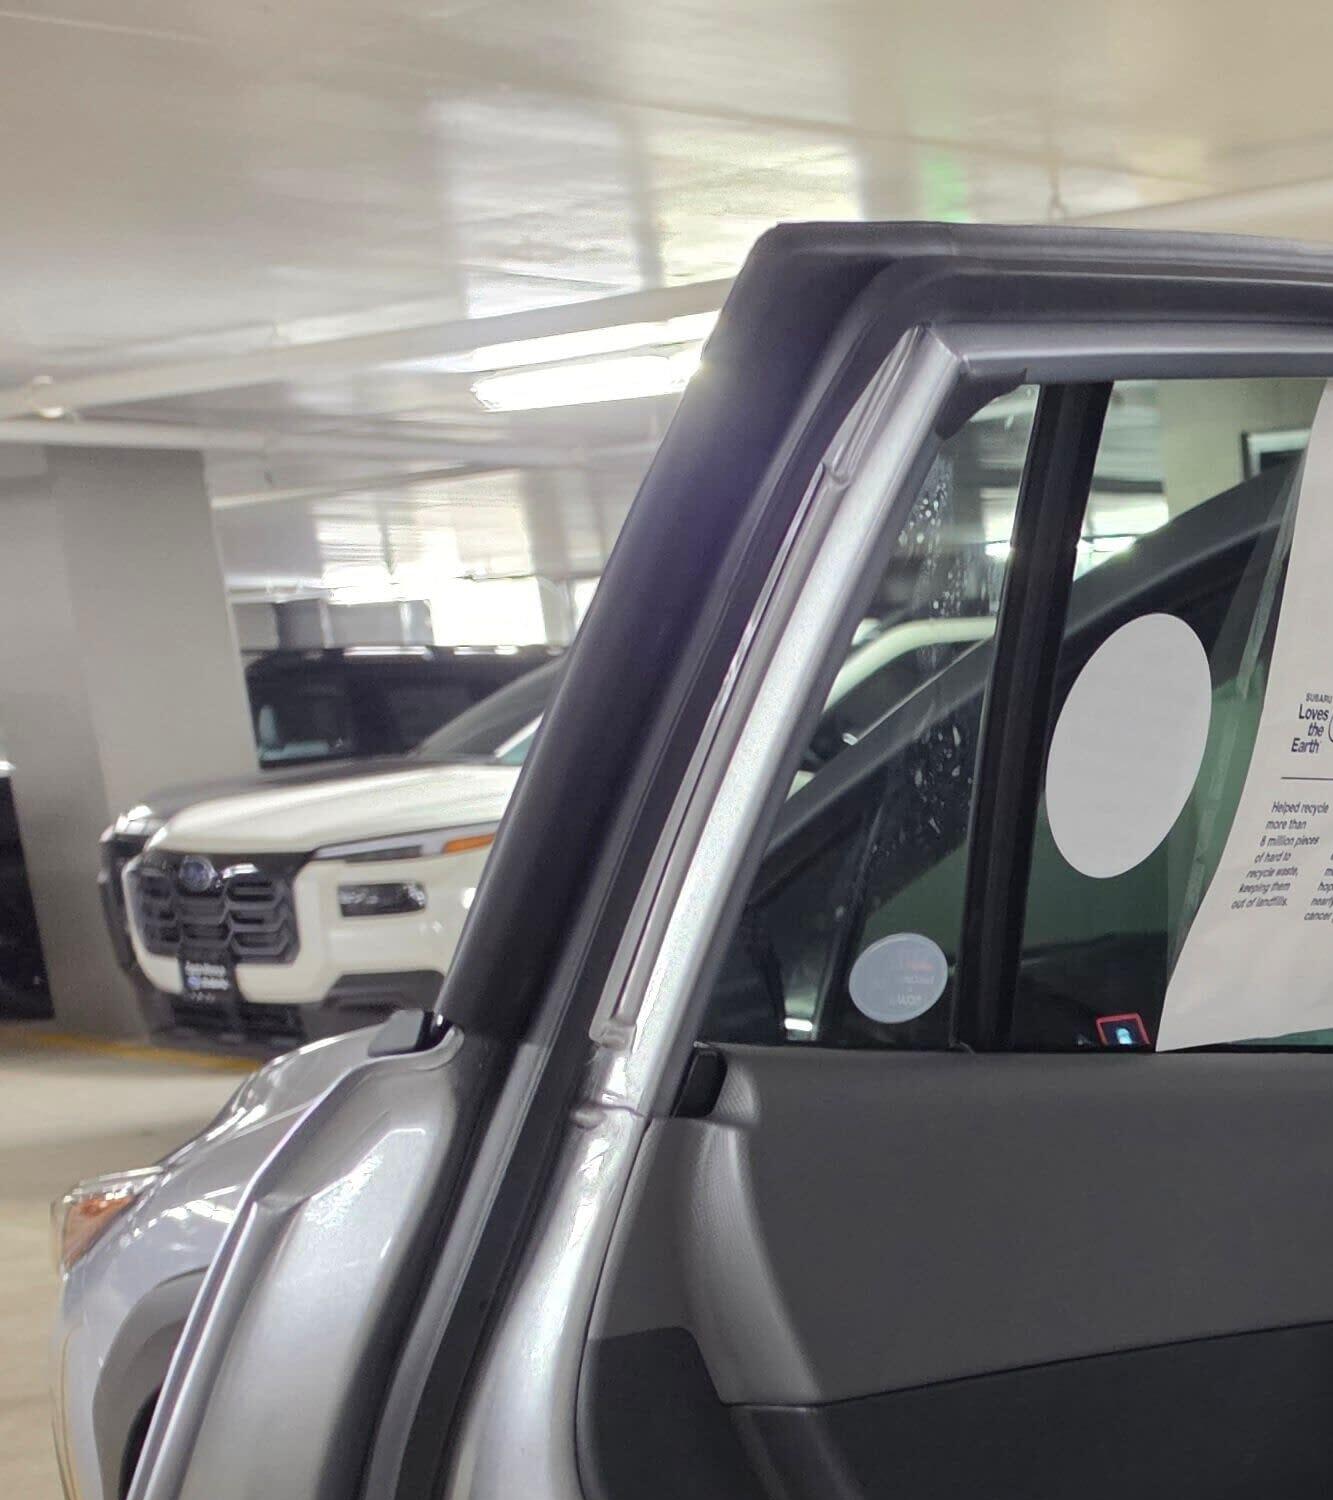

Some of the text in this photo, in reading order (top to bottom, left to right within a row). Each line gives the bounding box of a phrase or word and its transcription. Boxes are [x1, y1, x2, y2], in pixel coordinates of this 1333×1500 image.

[1306, 693, 1333, 704] SUBARU
[1299, 704, 1329, 721] Loves
[1308, 722, 1325, 736] the
[1291, 738, 1320, 754] Earth
[1272, 801, 1329, 816] Helped recycle
[1265, 819, 1307, 830] more than
[1254, 852, 1264, 863] of
[1282, 852, 1292, 861] to
